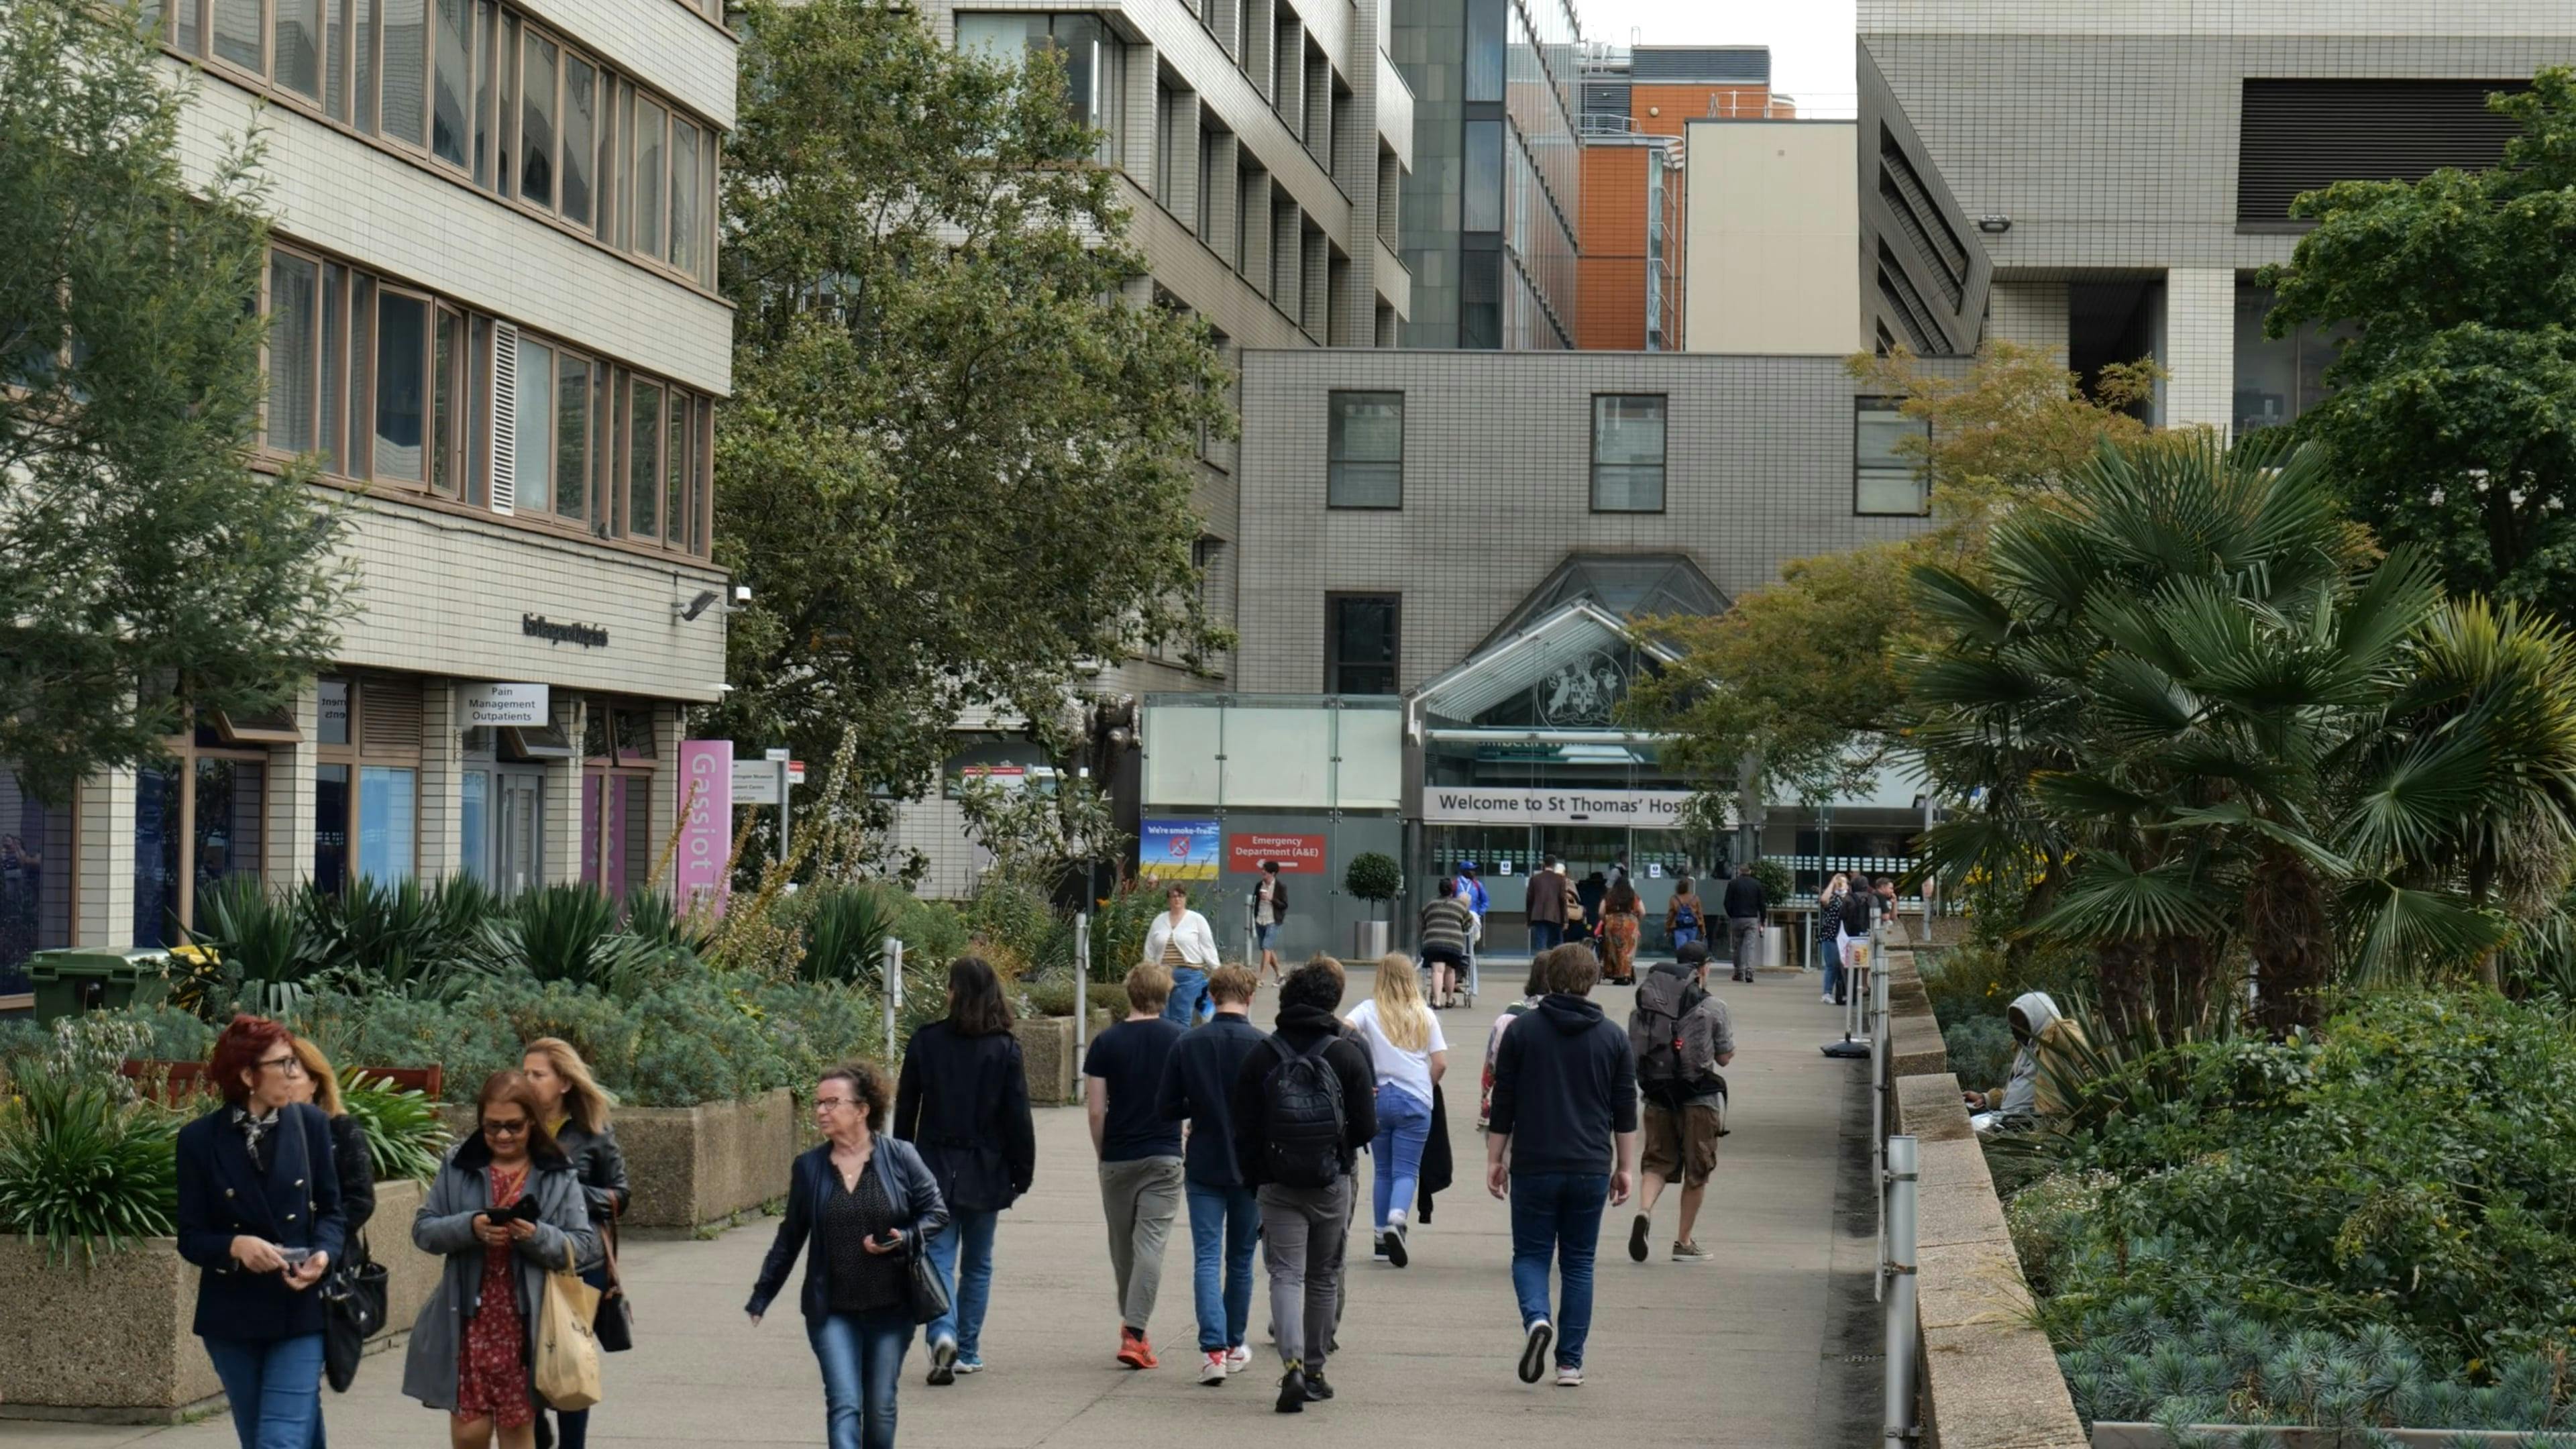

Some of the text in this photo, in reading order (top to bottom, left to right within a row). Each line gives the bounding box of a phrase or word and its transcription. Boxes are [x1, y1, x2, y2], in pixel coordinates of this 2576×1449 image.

[492, 686, 513, 696] Pain
[469, 699, 536, 710] Management
[472, 711, 532, 722] Outpatients
[690, 753, 716, 869] Gassiot
[1439, 794, 1518, 811] Welcome
[1524, 796, 1543, 811] to
[1548, 796, 1565, 812] St
[1649, 798, 1696, 818] Hosp
[1148, 826, 1169, 834] We're
[1252, 836, 1303, 847] Emergency
[1235, 847, 1319, 857] Department (A&E)
